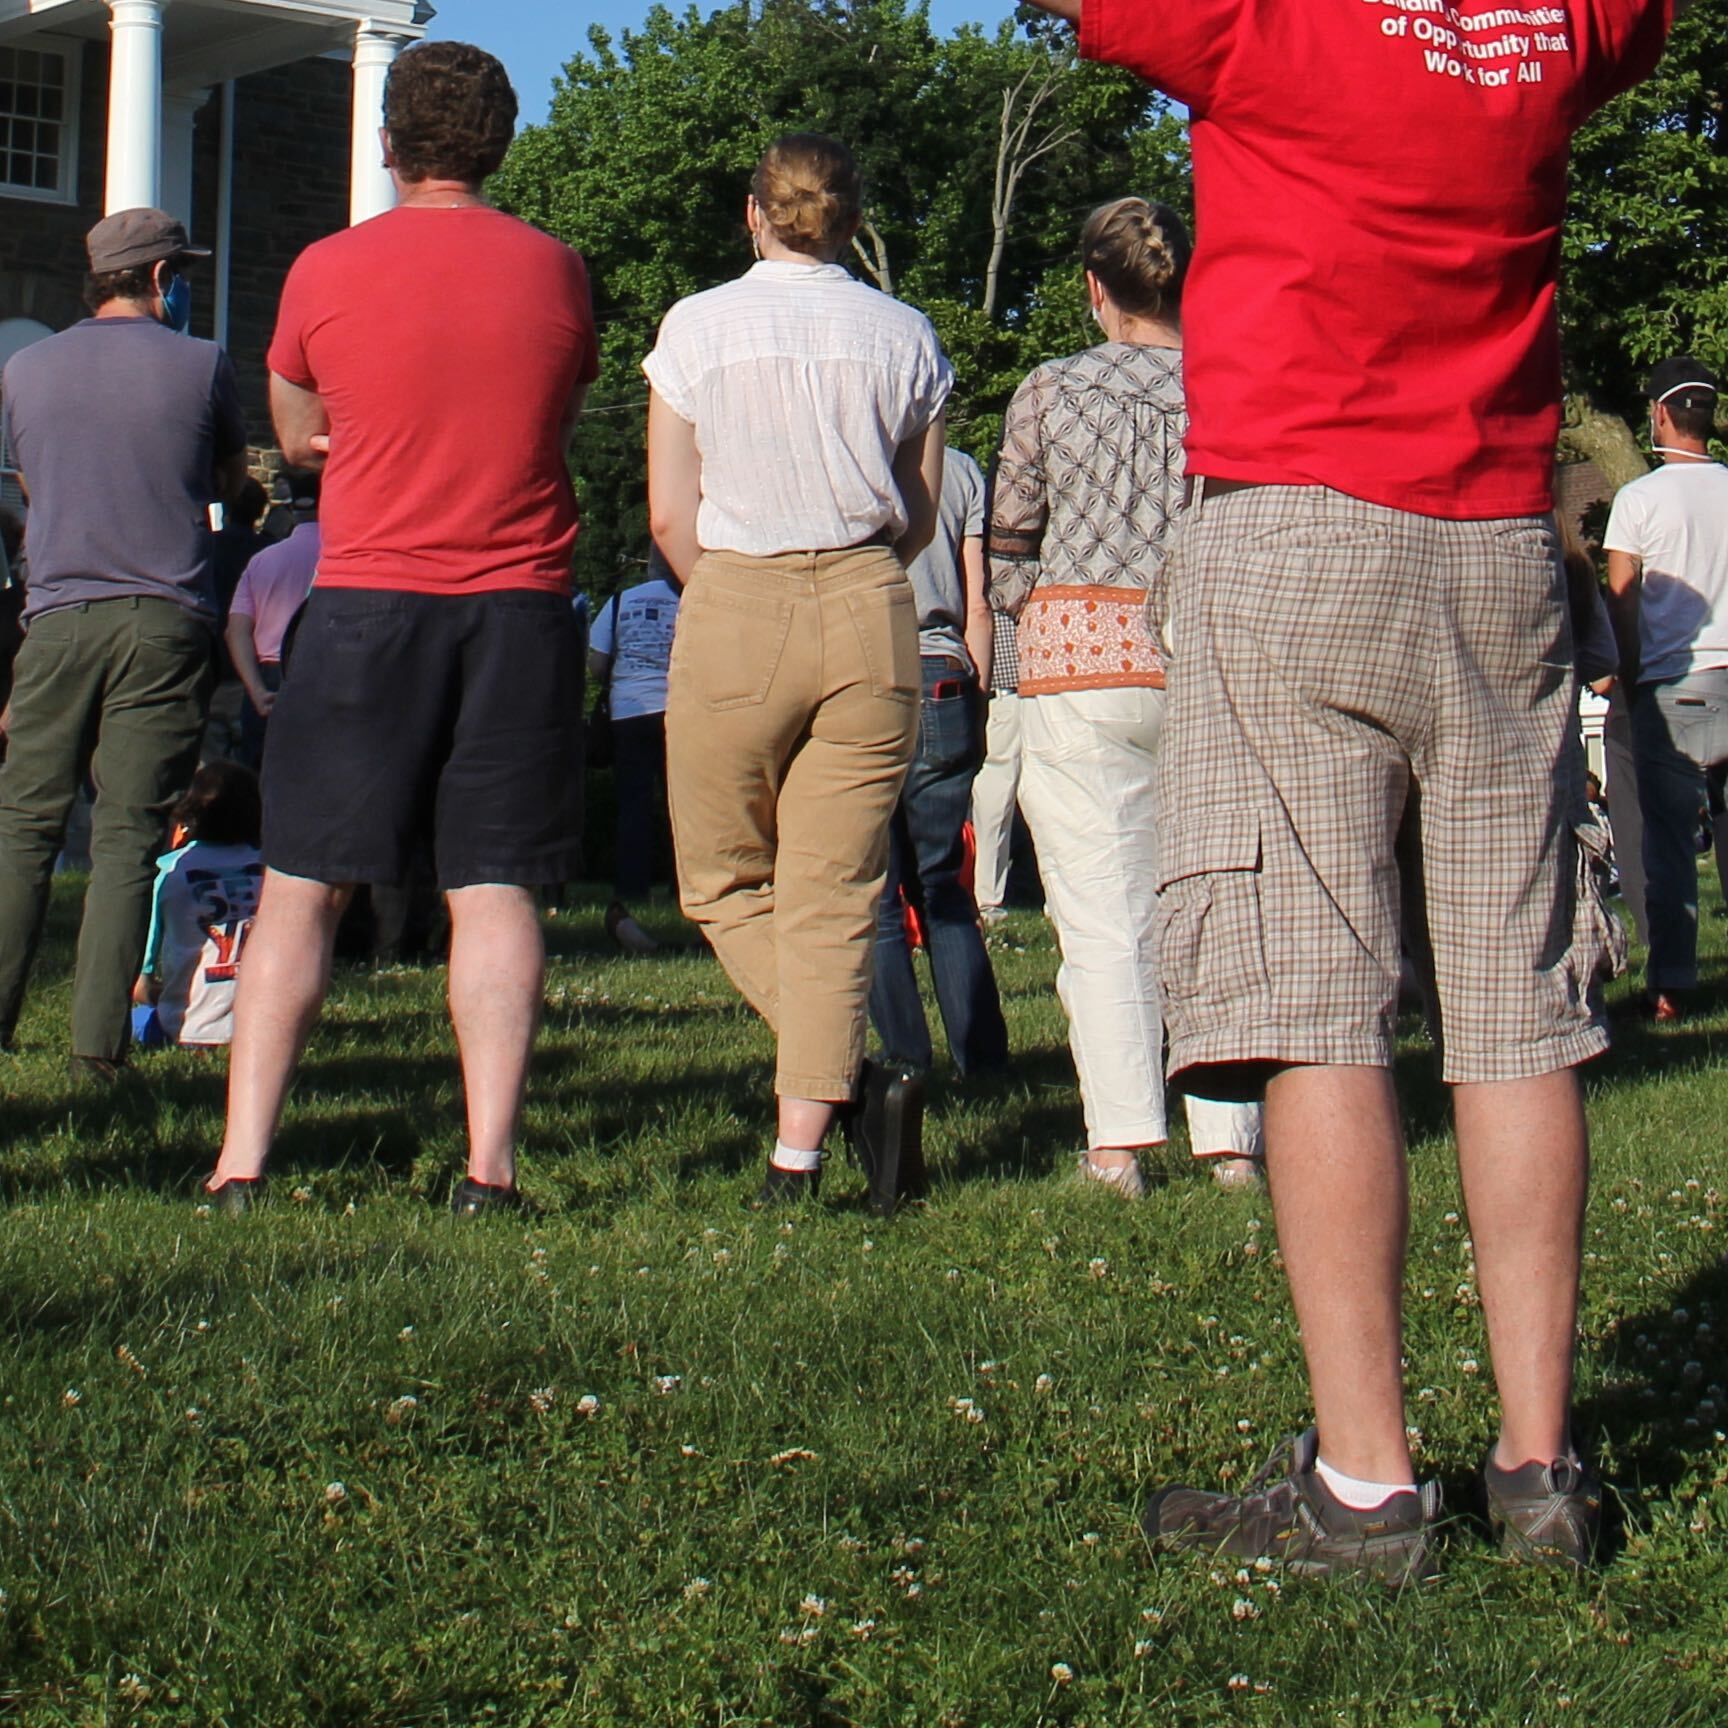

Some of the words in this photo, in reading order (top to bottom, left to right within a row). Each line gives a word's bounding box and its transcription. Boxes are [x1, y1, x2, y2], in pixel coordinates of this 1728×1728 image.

[1380, 15, 1408, 37] of
[1412, 18, 1530, 59] Opprtunity
[1533, 31, 1569, 52] that
[1423, 49, 1475, 84] Wok
[1477, 67, 1510, 87] for
[1516, 61, 1542, 83] All
